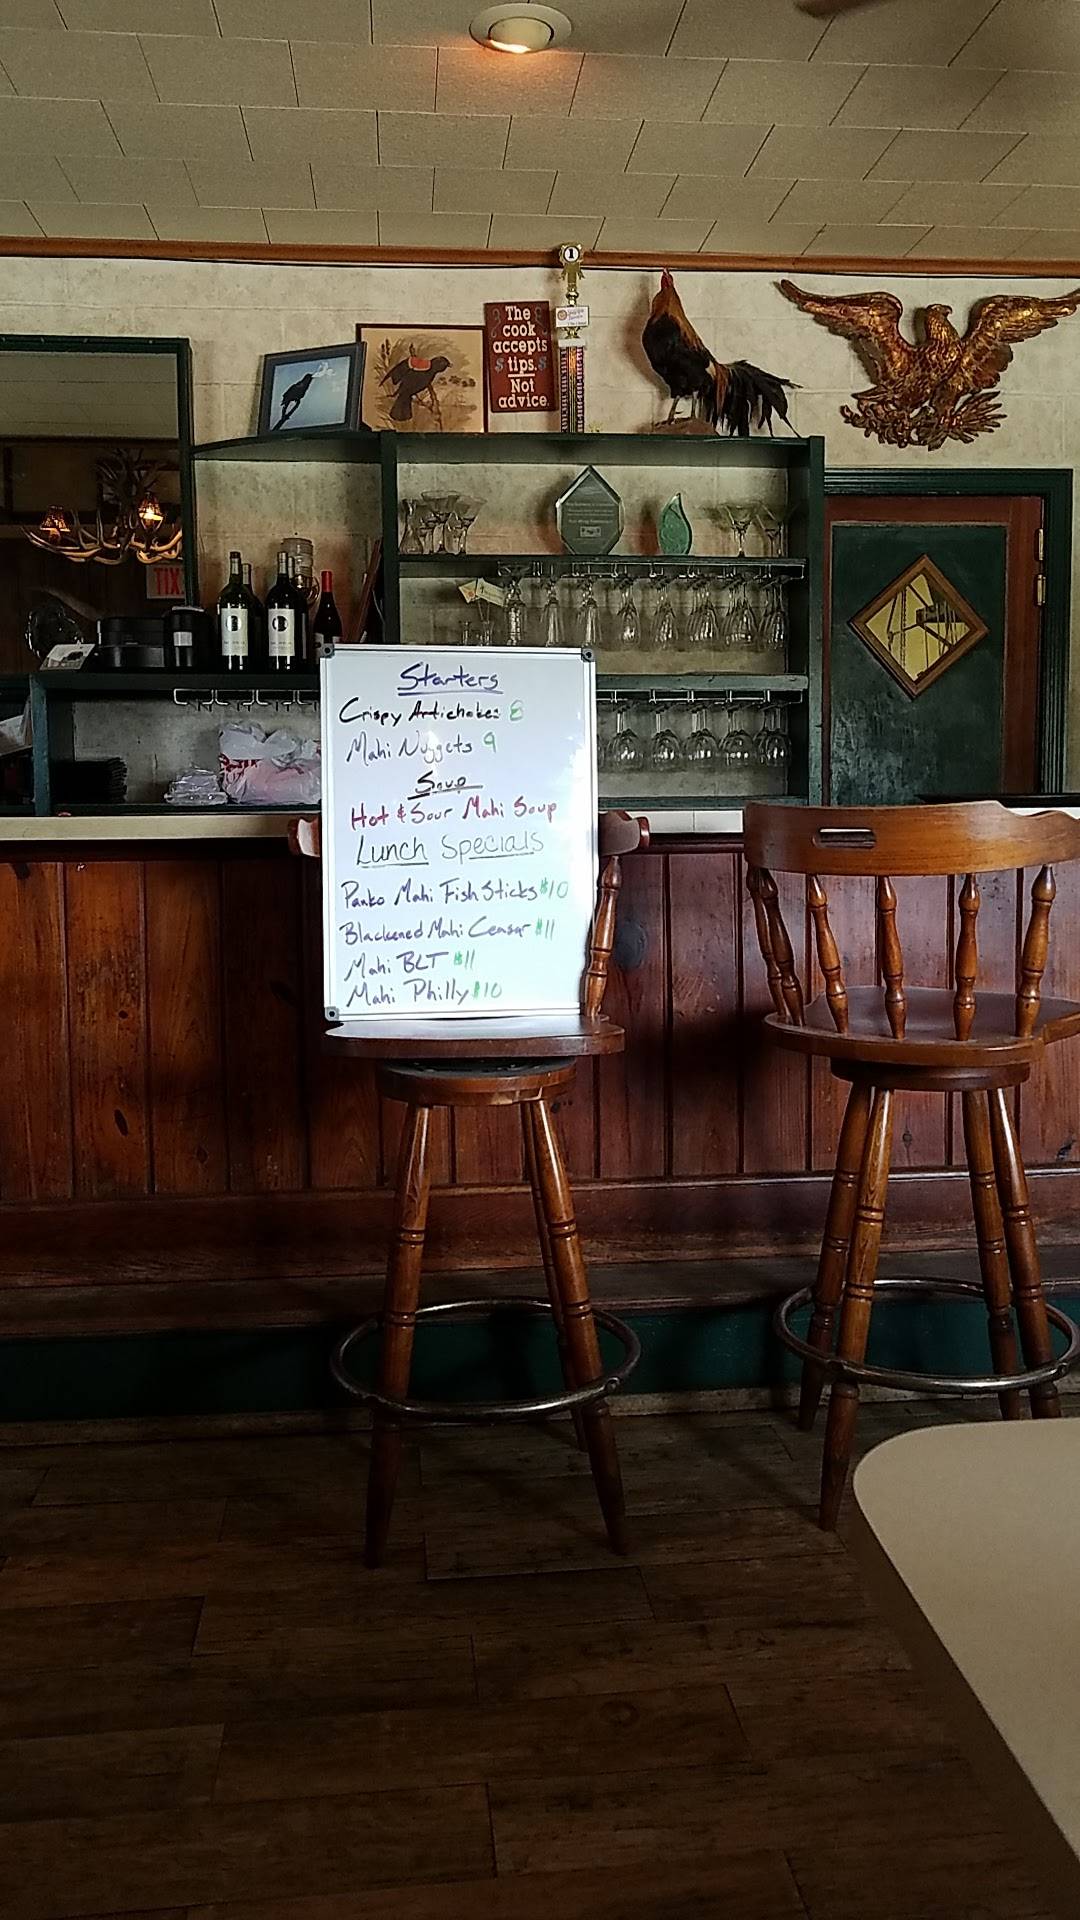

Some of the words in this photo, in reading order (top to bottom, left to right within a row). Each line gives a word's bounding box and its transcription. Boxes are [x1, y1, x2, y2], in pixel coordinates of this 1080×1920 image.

[568, 248, 575, 259] 1
[505, 305, 531, 321] The
[503, 322, 536, 337] cook
[493, 338, 548, 355] accepts
[508, 356, 538, 374] tips.
[510, 379, 535, 393] Not
[498, 394, 550, 409] advice.
[397, 661, 499, 690] Starters
[339, 697, 402, 727] Crispy
[347, 731, 391, 766] Mahi
[398, 730, 473, 764] Nuggets
[482, 732, 497, 753] 9
[414, 771, 467, 794] Soup
[351, 802, 389, 830] Hot
[410, 802, 453, 825] Sour
[462, 796, 505, 820] Mahi
[513, 796, 558, 823] Soup
[356, 835, 428, 865] Lunch
[441, 831, 544, 864] Specials
[341, 880, 385, 909] Panko
[394, 877, 433, 906] Mahi
[439, 877, 480, 904] Fish
[481, 878, 538, 902] Sticks
[539, 877, 569, 900] $10
[339, 920, 424, 945] Blackened
[427, 917, 464, 939] Mahi
[534, 917, 556, 941] $11
[344, 952, 391, 982] Mahi
[396, 951, 450, 974] BLT
[453, 949, 476, 971] $11
[347, 982, 395, 1008] Mahi
[403, 978, 470, 1006] Philly
